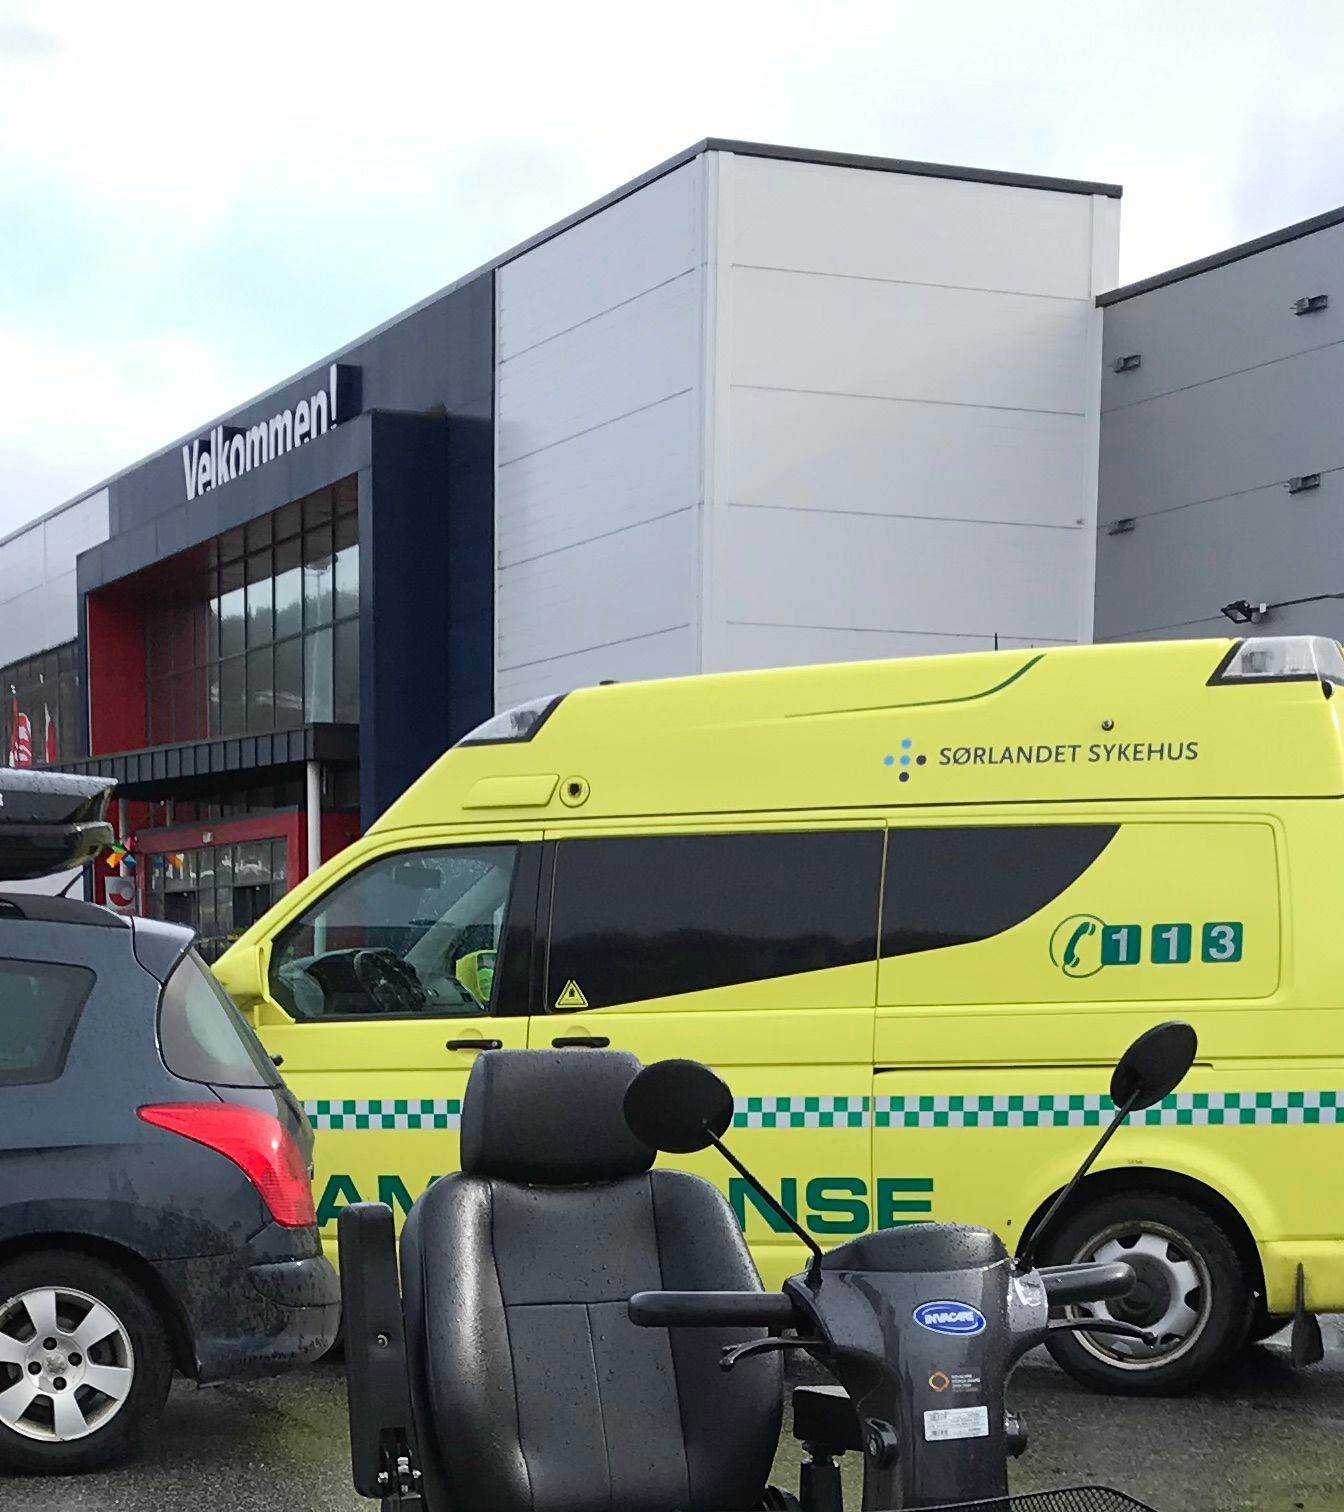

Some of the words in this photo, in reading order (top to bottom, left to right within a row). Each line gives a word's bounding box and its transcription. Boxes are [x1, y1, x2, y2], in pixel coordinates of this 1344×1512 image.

[181, 363, 338, 501] Velkommen!
[939, 744, 1082, 766] SØRLANDET
[1088, 741, 1199, 763] SYKEHUS
[924, 1311, 976, 1325] INVACARE
